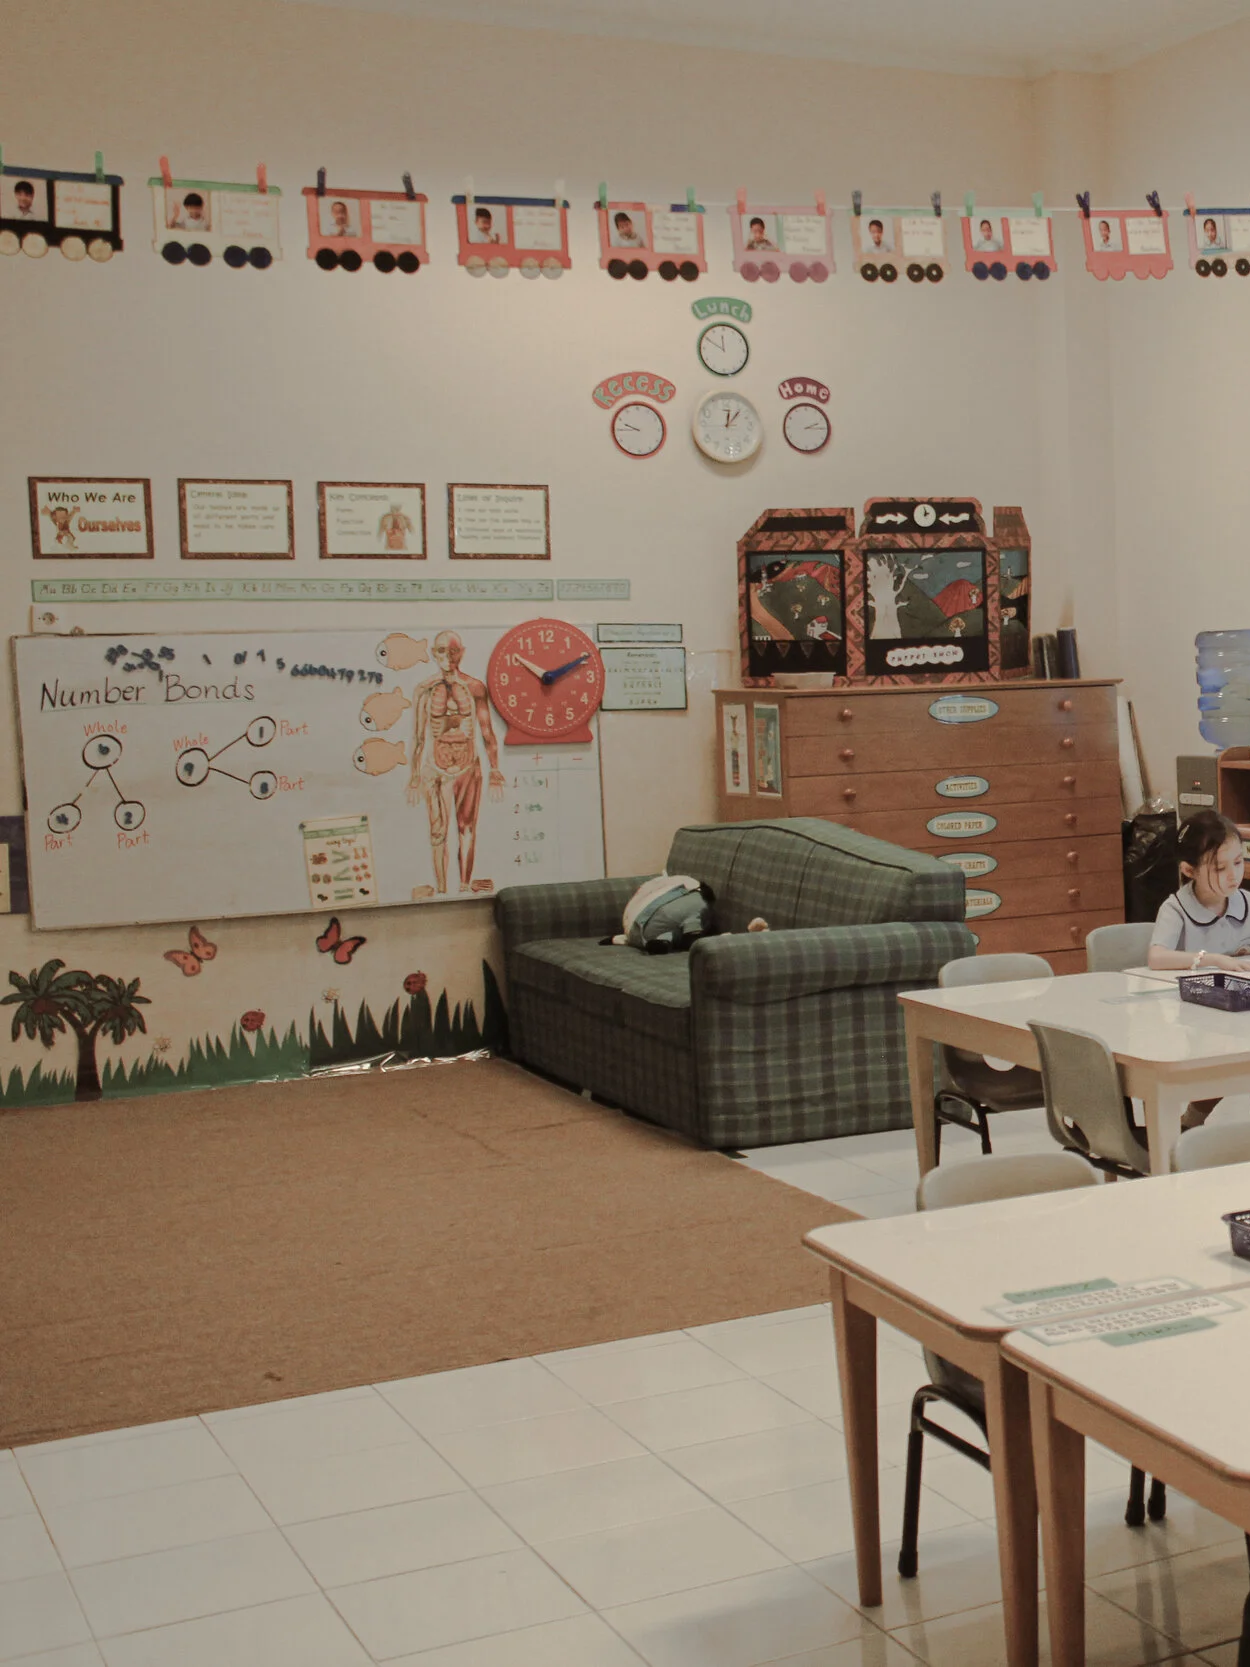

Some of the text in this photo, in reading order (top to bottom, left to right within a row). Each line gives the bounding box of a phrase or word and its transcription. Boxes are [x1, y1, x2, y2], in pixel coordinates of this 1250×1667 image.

[694, 299, 750, 321] Lunch
[594, 375, 675, 406] Recess
[780, 382, 829, 401] Home
[48, 491, 136, 504] Who We Are
[78, 516, 142, 534] Ourselves
[517, 637, 533, 650] 11
[538, 630, 555, 643] 12
[564, 636, 571, 649] 1
[504, 653, 520, 667] 10
[891, 649, 959, 662] PUPPET SHOW
[500, 673, 509, 686] 9
[586, 670, 595, 684] 3
[40, 677, 147, 712] Number
[165, 673, 255, 702] Bonds
[579, 692, 589, 705] 4
[508, 694, 518, 708] 8
[525, 708, 535, 722] 7
[545, 713, 554, 727] 6
[566, 707, 575, 721] 5
[83, 720, 128, 736] Whole
[258, 726, 265, 738] 1
[280, 720, 309, 736] Part
[173, 733, 209, 752] Whole
[183, 762, 195, 776] 9
[279, 776, 305, 791] Part
[124, 811, 133, 825] 2
[936, 821, 961, 831] COLORED
[44, 833, 73, 851] Part
[117, 831, 150, 849] Part
[966, 897, 993, 907] ATERIALS
